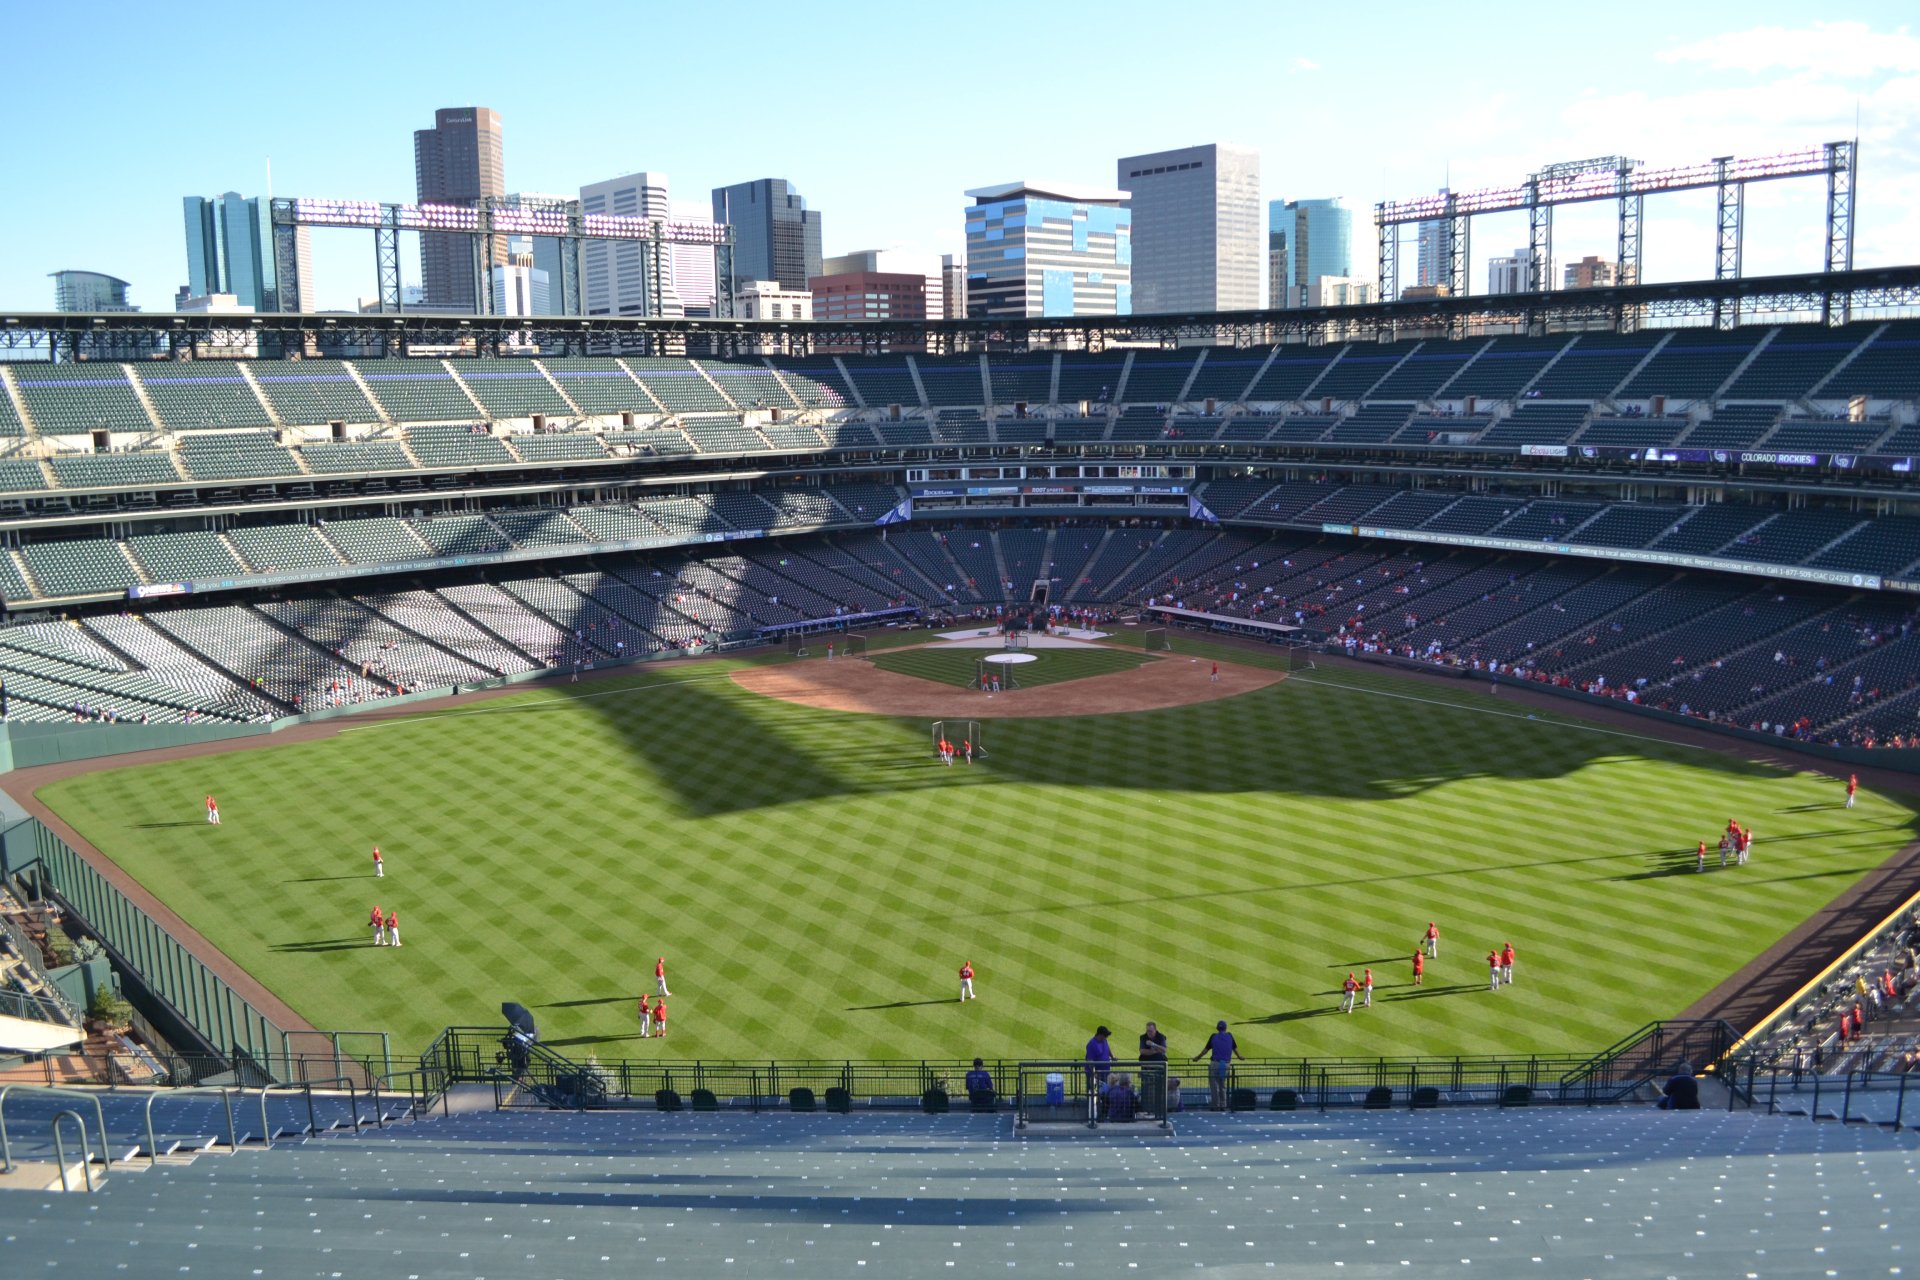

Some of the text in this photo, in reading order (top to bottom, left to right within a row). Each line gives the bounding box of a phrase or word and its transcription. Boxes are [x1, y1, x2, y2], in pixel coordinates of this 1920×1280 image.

[1530, 445, 1549, 455] Coors
[1742, 452, 1812, 464] COLORADO ROCKIES
[1408, 532, 1430, 540] suspicious
[1521, 542, 1545, 551] ballpark?
[1570, 547, 1598, 556] something
[1620, 551, 1649, 559] authorities
[1694, 558, 1712, 567] Report
[1713, 560, 1742, 570] suspicious
[235, 577, 267, 587] something
[268, 574, 300, 583] suspicious
[414, 561, 439, 569] ballpark?
[466, 556, 494, 564] something
[1890, 580, 1906, 589] MLB
